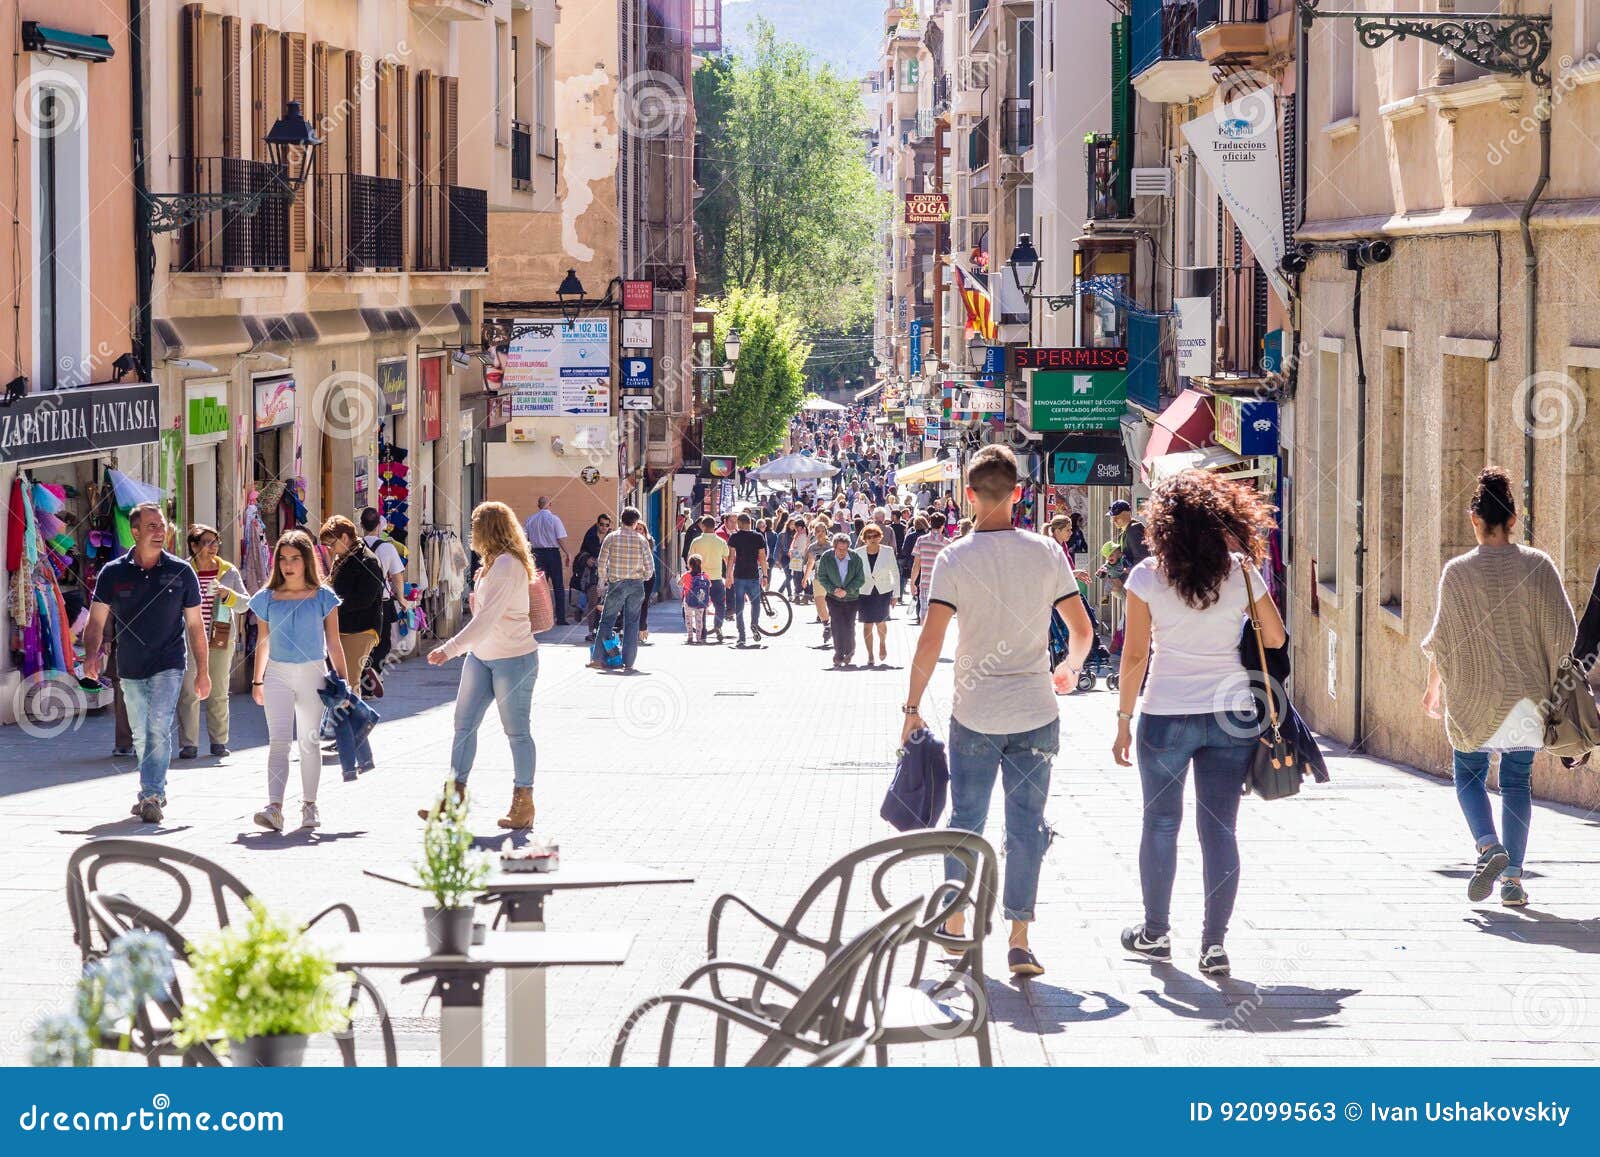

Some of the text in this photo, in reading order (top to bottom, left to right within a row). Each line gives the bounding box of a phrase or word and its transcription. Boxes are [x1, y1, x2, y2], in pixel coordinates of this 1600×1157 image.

[1213, 141, 1267, 149] Traduccions
[1222, 152, 1256, 160] oficials
[908, 202, 946, 214] YOGA
[579, 323, 592, 333] 102
[594, 323, 608, 333] 103
[1036, 350, 1129, 366] PERMISO
[630, 361, 646, 377] P
[1, 399, 157, 448] ZAPATERIA FANTASIA
